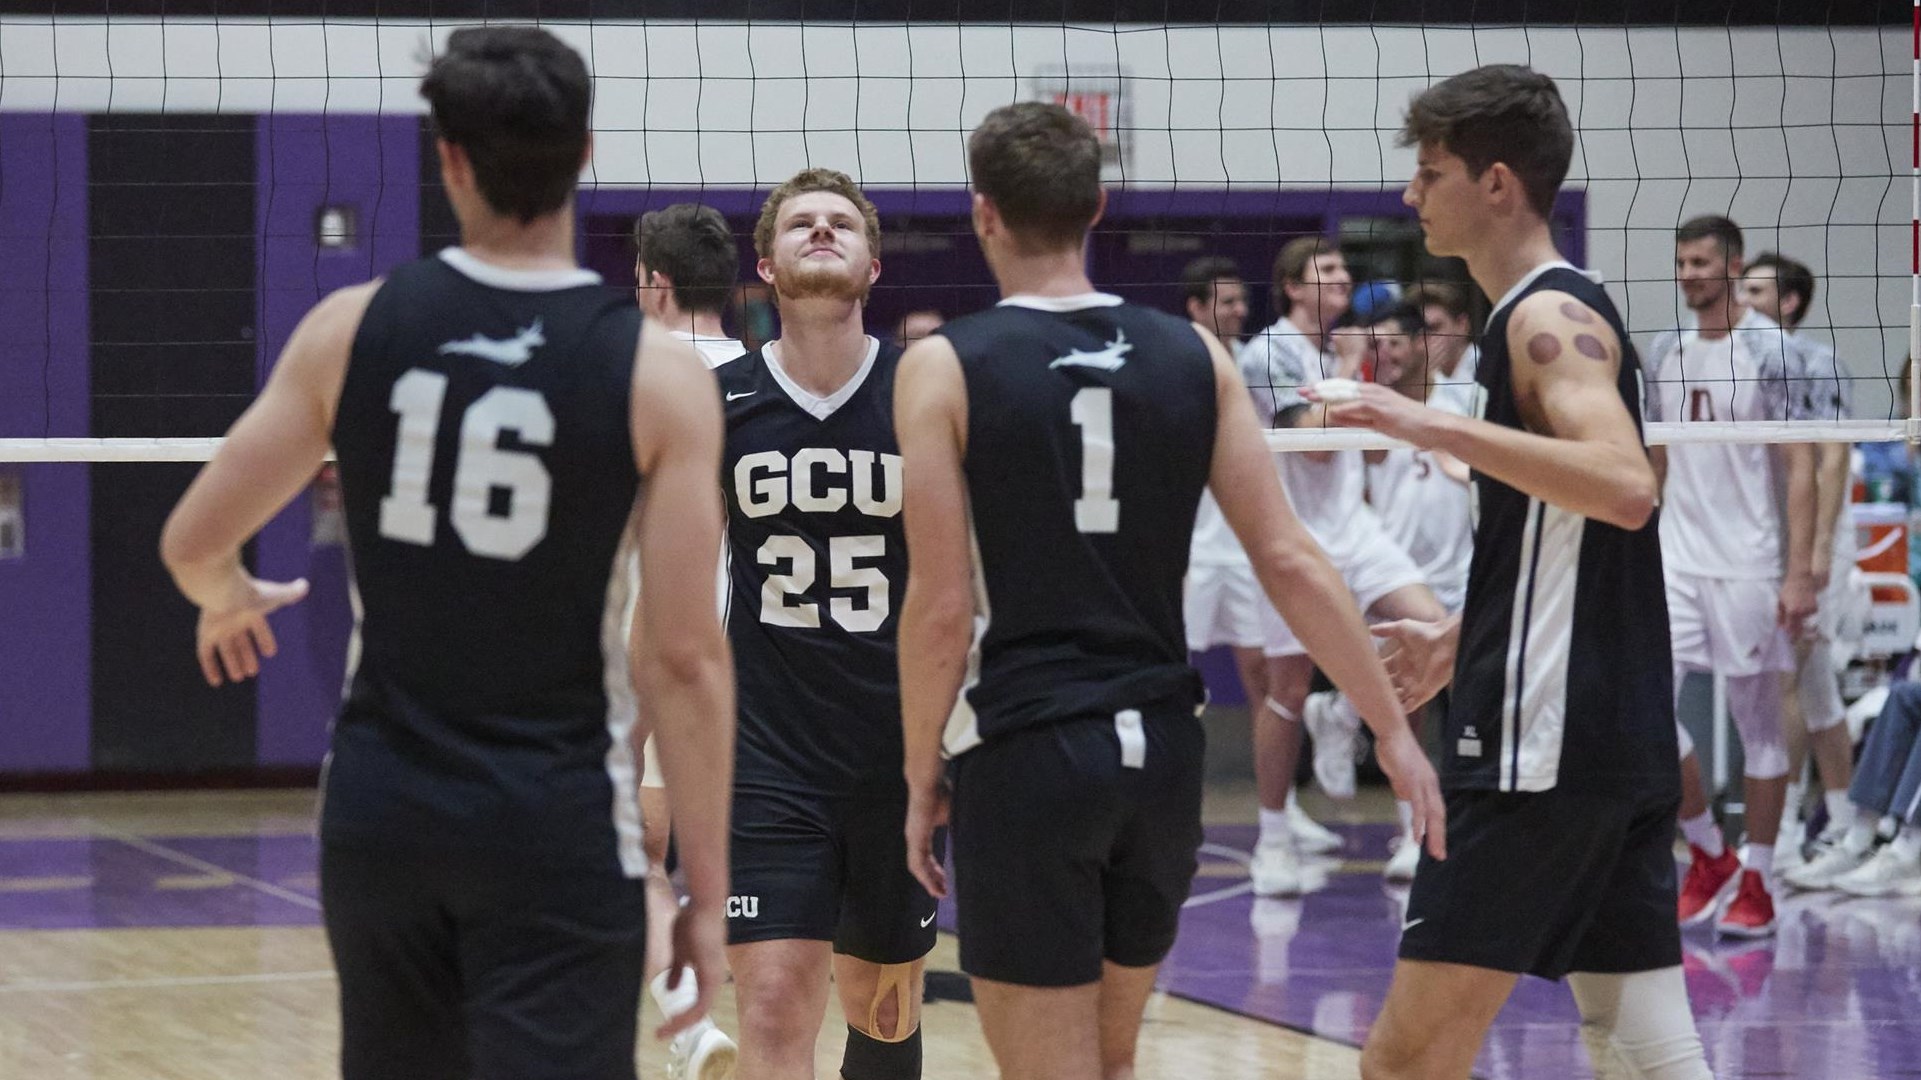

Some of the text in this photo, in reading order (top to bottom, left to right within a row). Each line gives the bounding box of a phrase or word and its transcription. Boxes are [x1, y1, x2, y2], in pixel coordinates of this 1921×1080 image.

[379, 367, 556, 562] 16
[734, 448, 904, 518] GCU
[1070, 387, 1120, 533] 1
[757, 535, 889, 632] 25
[723, 895, 759, 918] CU
